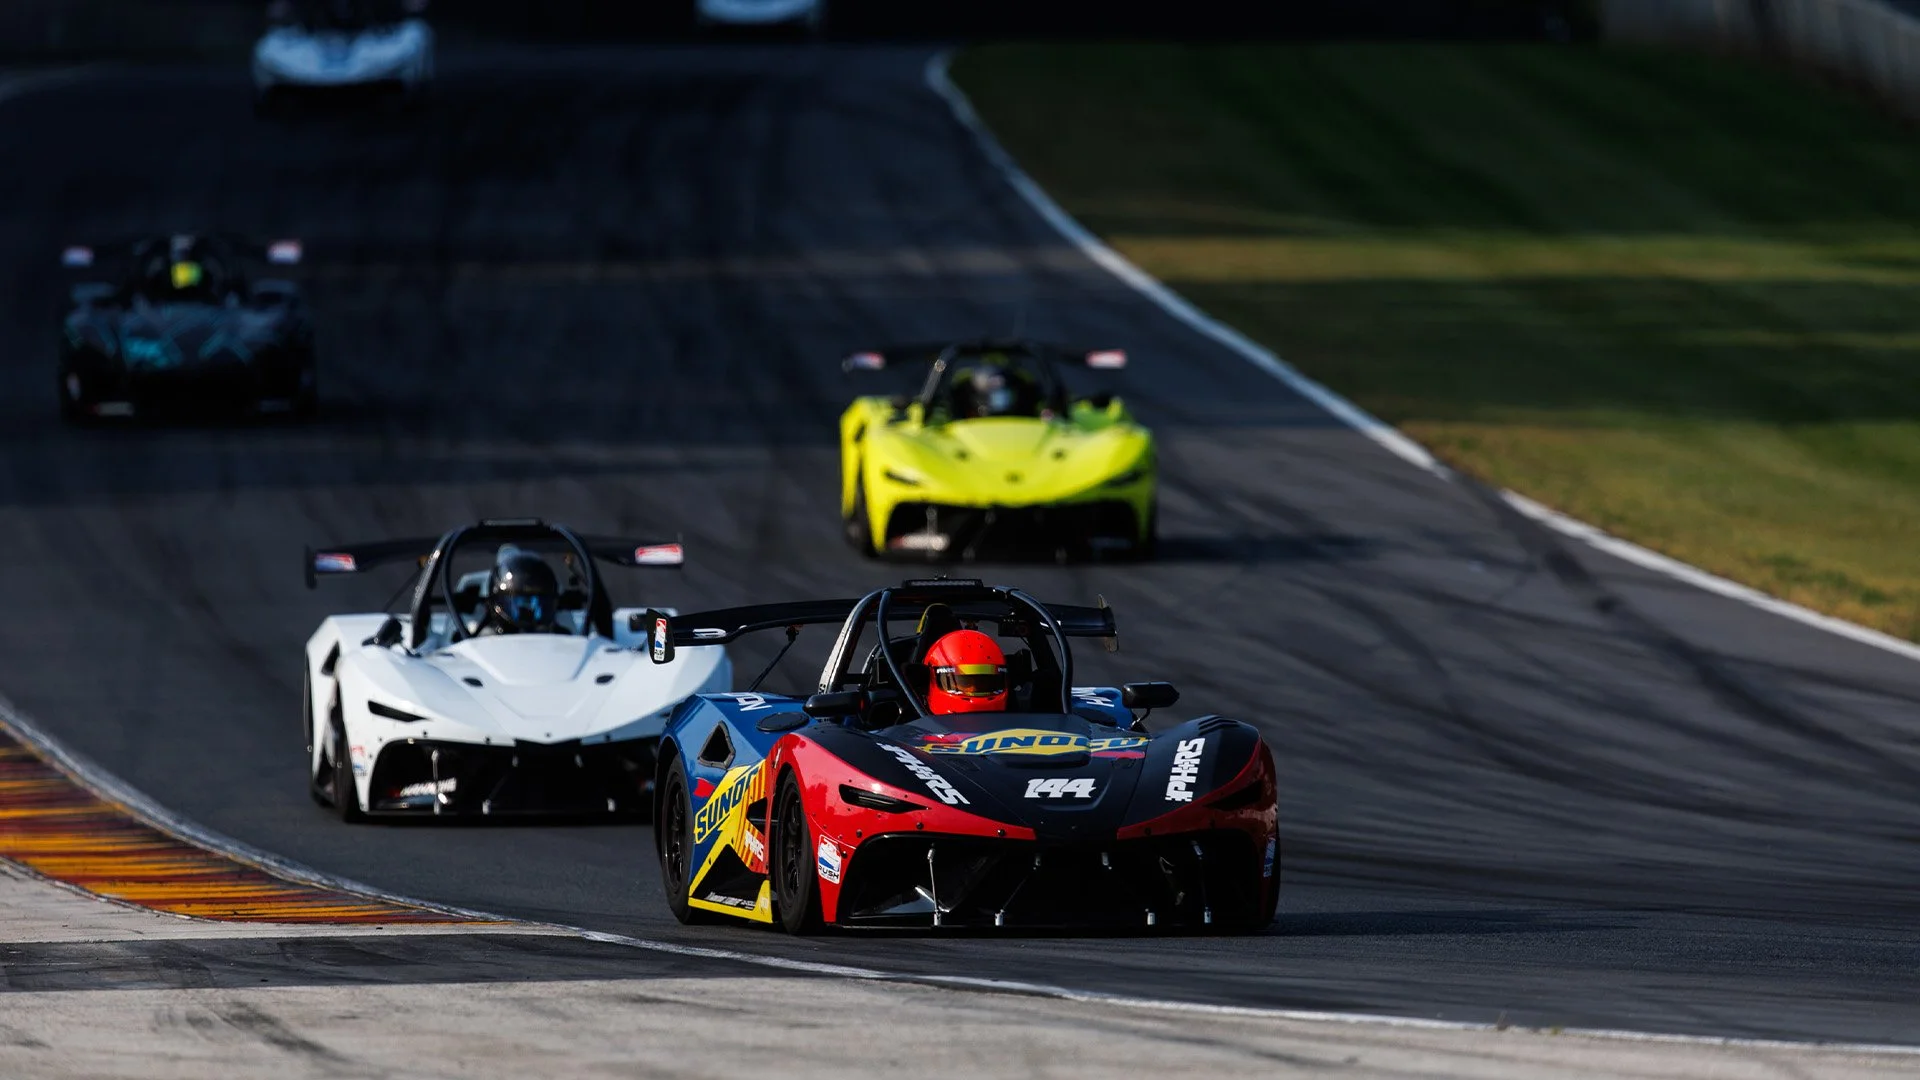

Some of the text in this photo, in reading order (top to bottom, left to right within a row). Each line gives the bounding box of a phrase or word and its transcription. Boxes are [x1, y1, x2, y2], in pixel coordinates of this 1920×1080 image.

[927, 735, 1147, 754] SUNOCO
[1023, 778, 1097, 799] 144
[818, 864, 840, 880] RUSH
